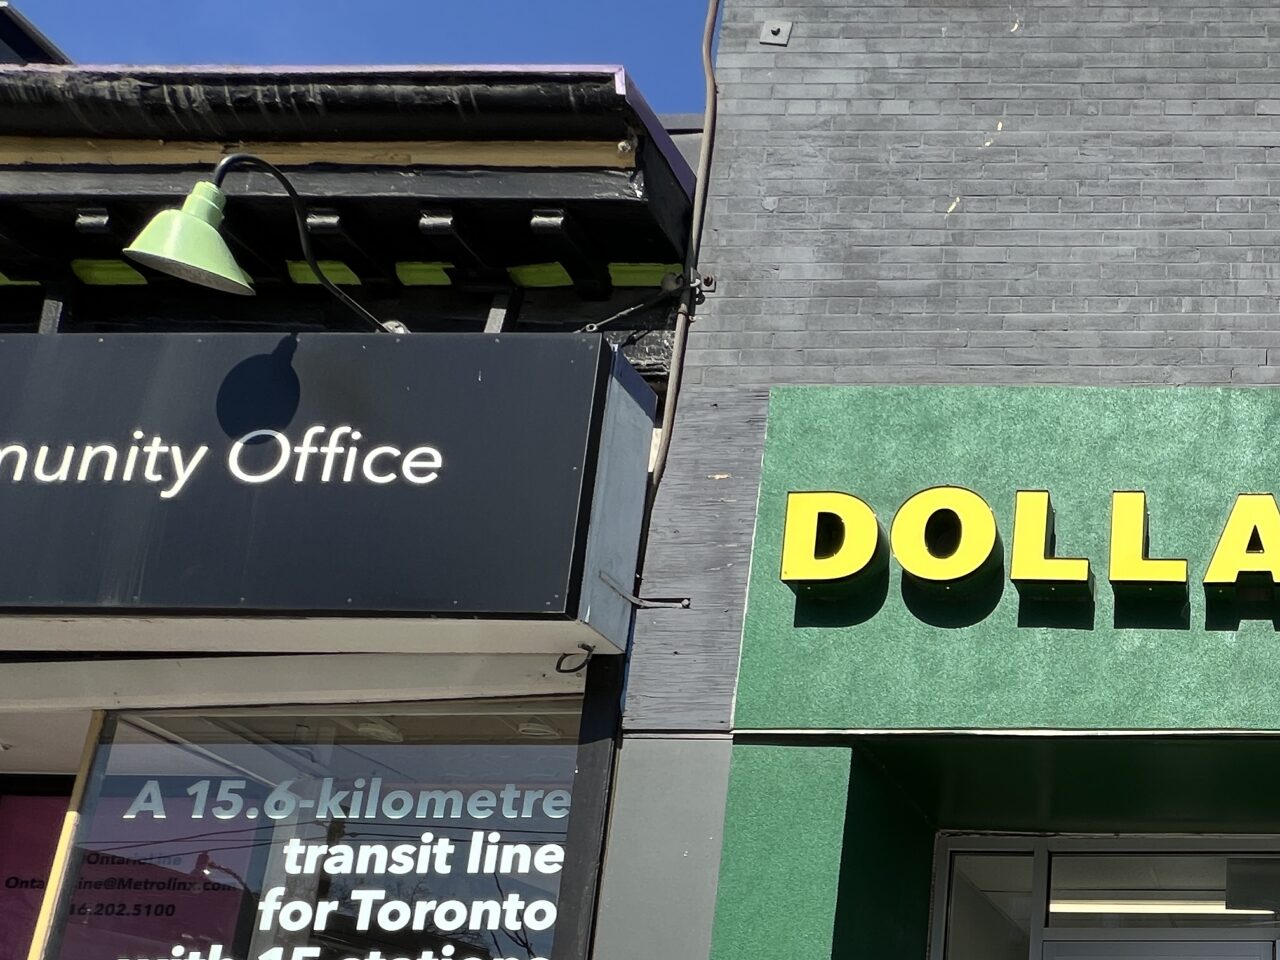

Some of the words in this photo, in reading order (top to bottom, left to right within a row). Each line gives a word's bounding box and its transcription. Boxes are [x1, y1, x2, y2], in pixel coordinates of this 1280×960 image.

[228, 425, 443, 484] Office
[122, 780, 167, 820] A
[185, 777, 571, 820] 15.6-kilometre
[283, 831, 454, 875] transit
[466, 831, 565, 875] line
[257, 886, 338, 932] for
[350, 889, 557, 932] Toronto
